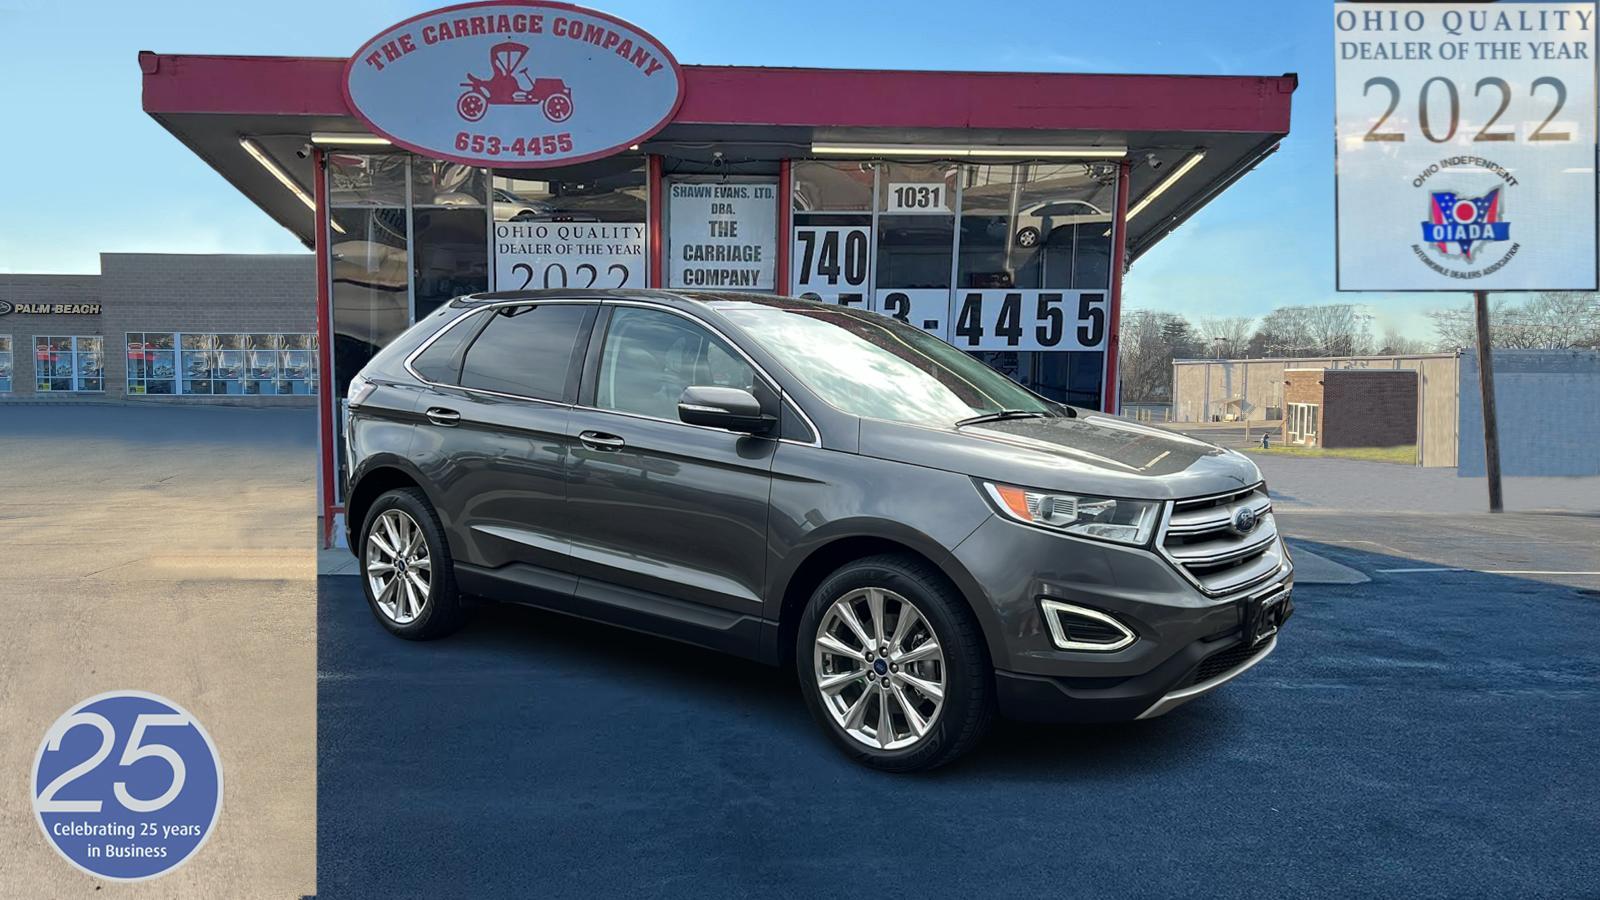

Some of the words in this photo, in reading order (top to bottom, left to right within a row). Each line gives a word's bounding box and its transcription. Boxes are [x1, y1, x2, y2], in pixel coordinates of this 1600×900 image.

[1336, 10, 1425, 31] OHIO
[1442, 10, 1592, 36] QUALITY
[365, 33, 416, 71] THE
[422, 14, 544, 46] CARRIAGE
[552, 17, 664, 77] COMPANY
[1340, 42, 1433, 60] DEALER
[1439, 42, 1469, 60] OF
[1475, 42, 1522, 60] THE
[1528, 42, 1589, 60] YEAR
[1363, 76, 1571, 143] 2022
[455, 131, 573, 156] 653-4455
[1412, 164, 1439, 188] OHIO
[1440, 156, 1519, 187] INDEPENDENT
[672, 186, 711, 198] SHAWN
[754, 187, 775, 199] LTD.
[894, 186, 941, 208] 1031
[711, 203, 736, 215] DBA.
[497, 226, 548, 239] OHIO
[557, 226, 644, 241] QUALITY
[708, 220, 738, 238] THE
[1432, 225, 1495, 241] OIADA
[499, 244, 552, 255] DEALER
[555, 244, 573, 255] OF
[576, 244, 603, 255] THE
[606, 244, 641, 255] YEAR
[683, 244, 762, 262] CARRIAGE
[797, 231, 868, 286] 740
[1411, 244, 1449, 276] AUTOMOBILE
[1449, 270, 1482, 279] DEALERS
[1482, 242, 1521, 276] ASSOCIATION
[683, 268, 761, 286] COMPANY
[14, 304, 50, 314] PALM
[54, 304, 100, 314] BEACH
